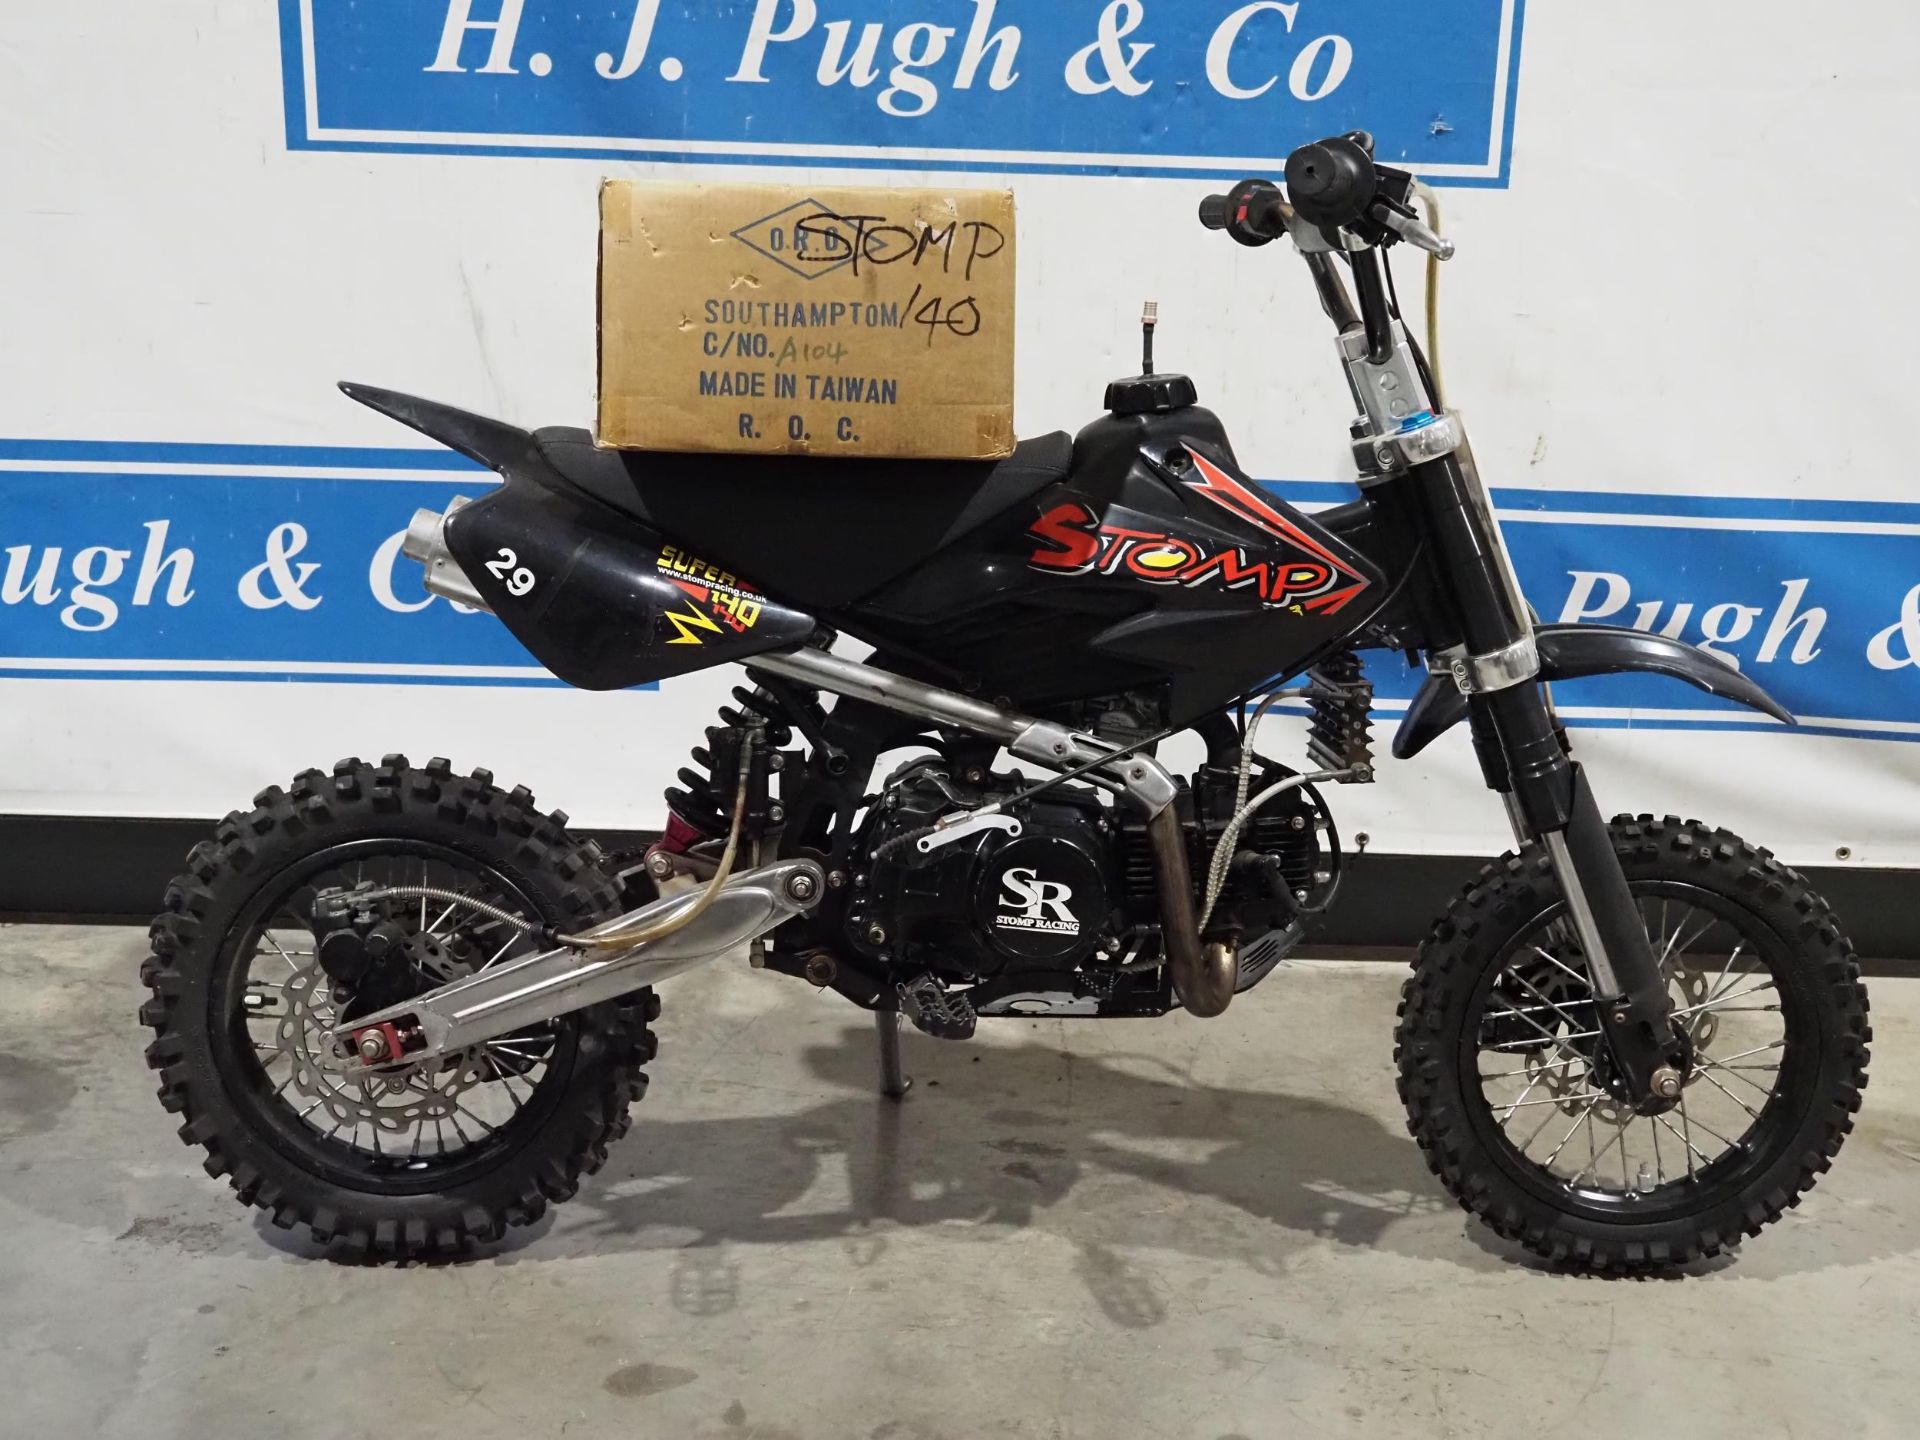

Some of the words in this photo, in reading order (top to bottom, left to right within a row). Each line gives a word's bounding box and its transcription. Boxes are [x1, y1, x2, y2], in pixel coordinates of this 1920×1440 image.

[423, 0, 553, 77] H.
[594, 0, 684, 82] J.
[725, 0, 1020, 117] Pugh
[1064, 0, 1154, 97] &
[1205, 1, 1353, 101] Co
[796, 213, 1005, 281] STOMP
[703, 331, 775, 358] C/NO.
[775, 336, 849, 367] A104
[699, 371, 765, 397] MADE
[775, 374, 797, 398] IN
[806, 375, 897, 405] TAIWAN
[739, 413, 761, 439] R.
[788, 415, 811, 441] O.
[837, 416, 860, 442] C.
[237, 522, 323, 610] &
[484, 547, 536, 596] 29
[656, 545, 736, 586] SUPER
[1025, 502, 1338, 607] STOMP
[657, 566, 767, 603] www.stompracing.co.uk
[711, 590, 762, 628] 140
[998, 867, 1080, 922] SR
[996, 915, 1035, 927] STOMP
[1035, 919, 1080, 931] RACING
